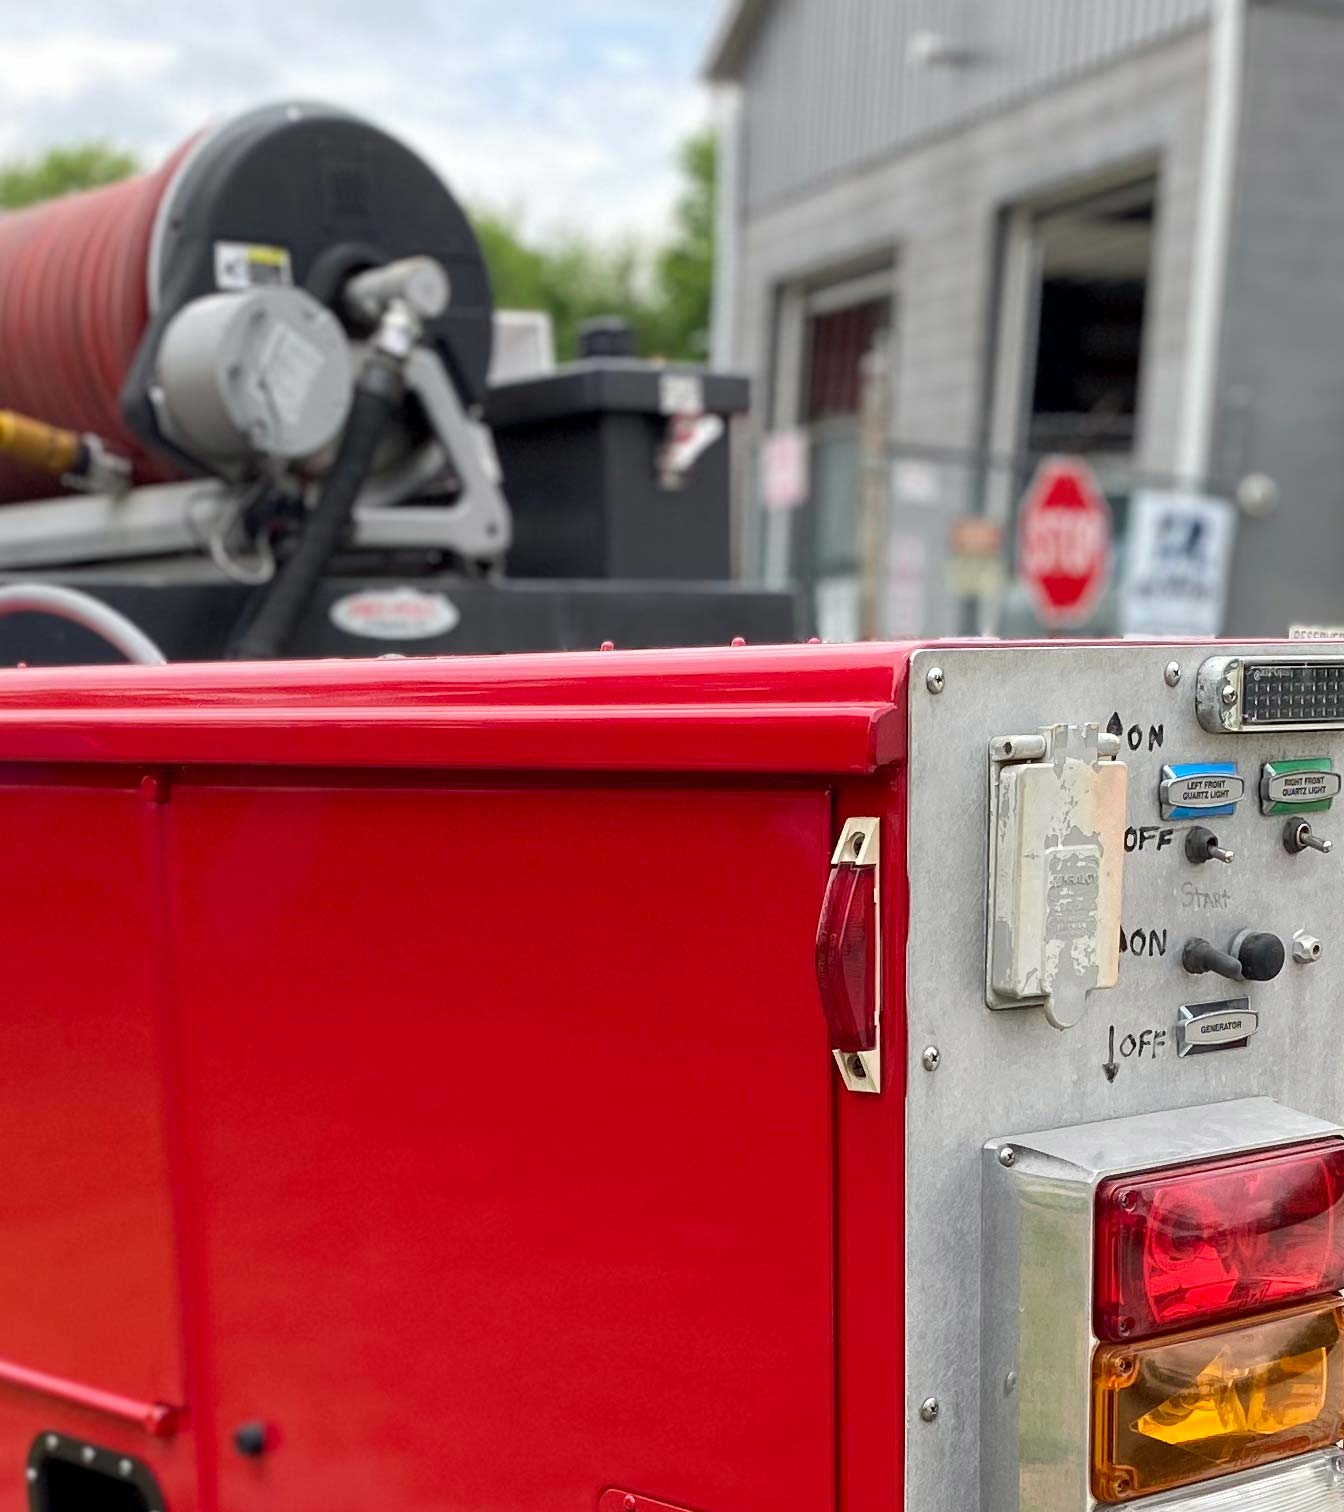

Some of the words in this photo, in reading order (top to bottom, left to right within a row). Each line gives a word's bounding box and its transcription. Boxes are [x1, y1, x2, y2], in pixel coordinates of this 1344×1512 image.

[1127, 724, 1164, 752] ON
[1186, 781, 1203, 790] LEFT
[1203, 779, 1226, 790] FRONT
[1284, 777, 1303, 787] RIGHT
[1304, 775, 1325, 786] FRONT
[1182, 790, 1209, 801] QUARTZ
[1210, 789, 1230, 800] LIGHT
[1282, 787, 1307, 797] QUARTZ
[1308, 785, 1328, 795] LIGHT
[1123, 826, 1174, 853] OFF
[1129, 927, 1167, 957] ON
[1200, 1020, 1242, 1034] GENERATOR
[1119, 1029, 1167, 1059] OFF
